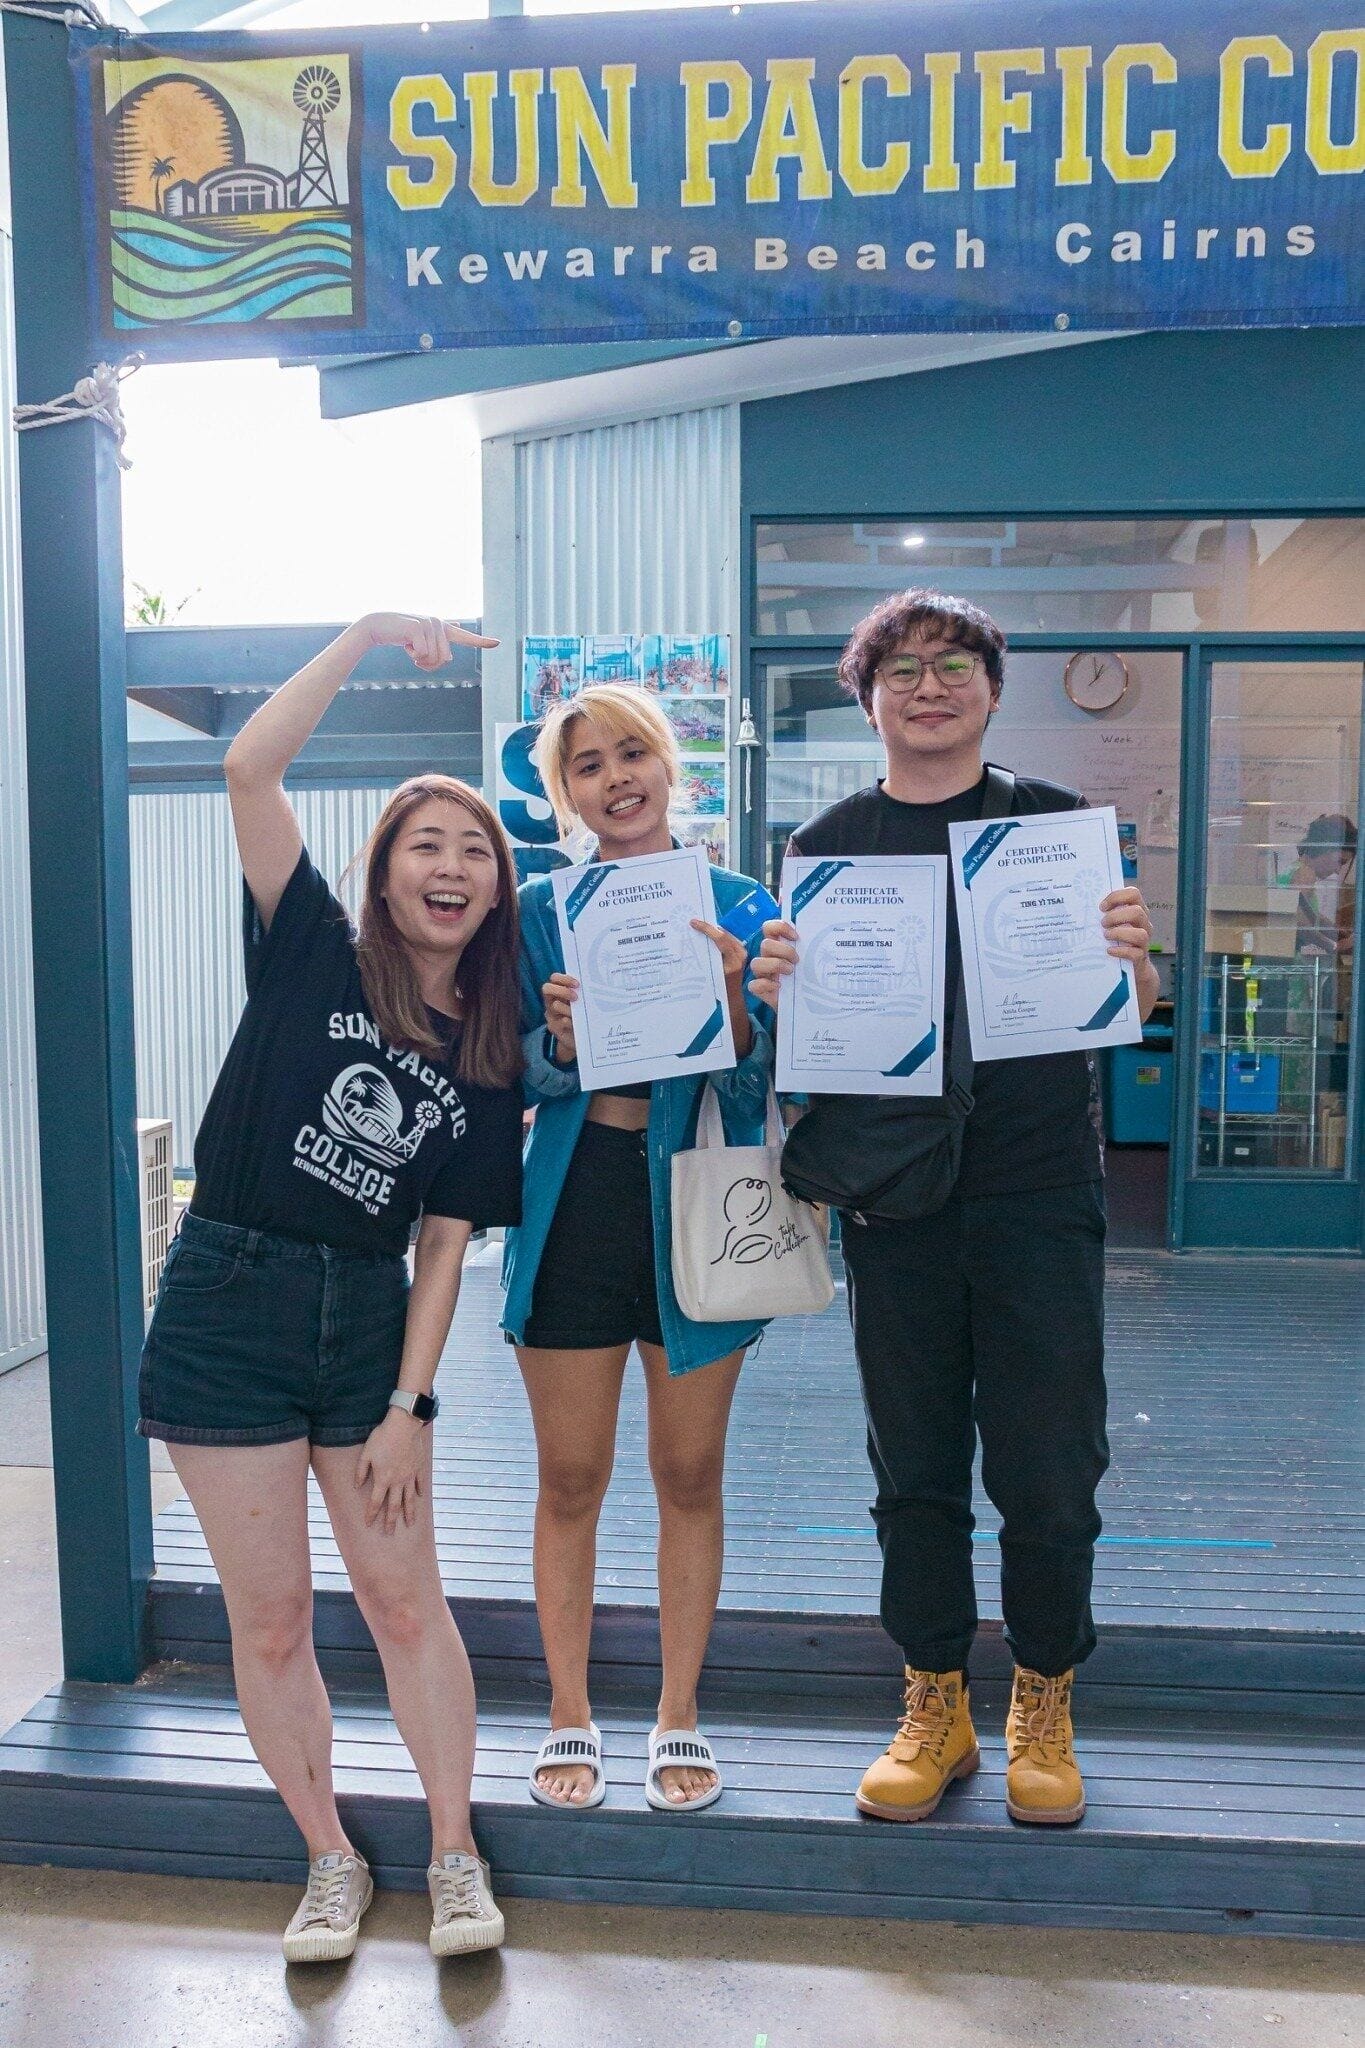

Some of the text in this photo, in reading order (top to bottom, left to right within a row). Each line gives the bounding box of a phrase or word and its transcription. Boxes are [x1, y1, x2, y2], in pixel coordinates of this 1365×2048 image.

[386, 62, 637, 211] SUN
[680, 42, 1178, 207] PACIFIC
[406, 220, 1317, 287] Kewarra Beach Cairns
[997, 852, 1077, 867] OF COMPLETION
[1005, 843, 1069, 857] CERTIFICATE
[598, 889, 673, 908] OF COMPLETION
[605, 881, 666, 898] CERTIFICATE
[834, 887, 898, 896] CERTIFICATE
[825, 896, 905, 905] OF COMPLETION
[875, 940, 893, 948] TSAI
[328, 1012, 380, 1050] SUN
[292, 1156, 356, 1198] KEWARRA BEACH
[542, 1740, 597, 1759] PUMA
[656, 1741, 711, 1760] PUMA
